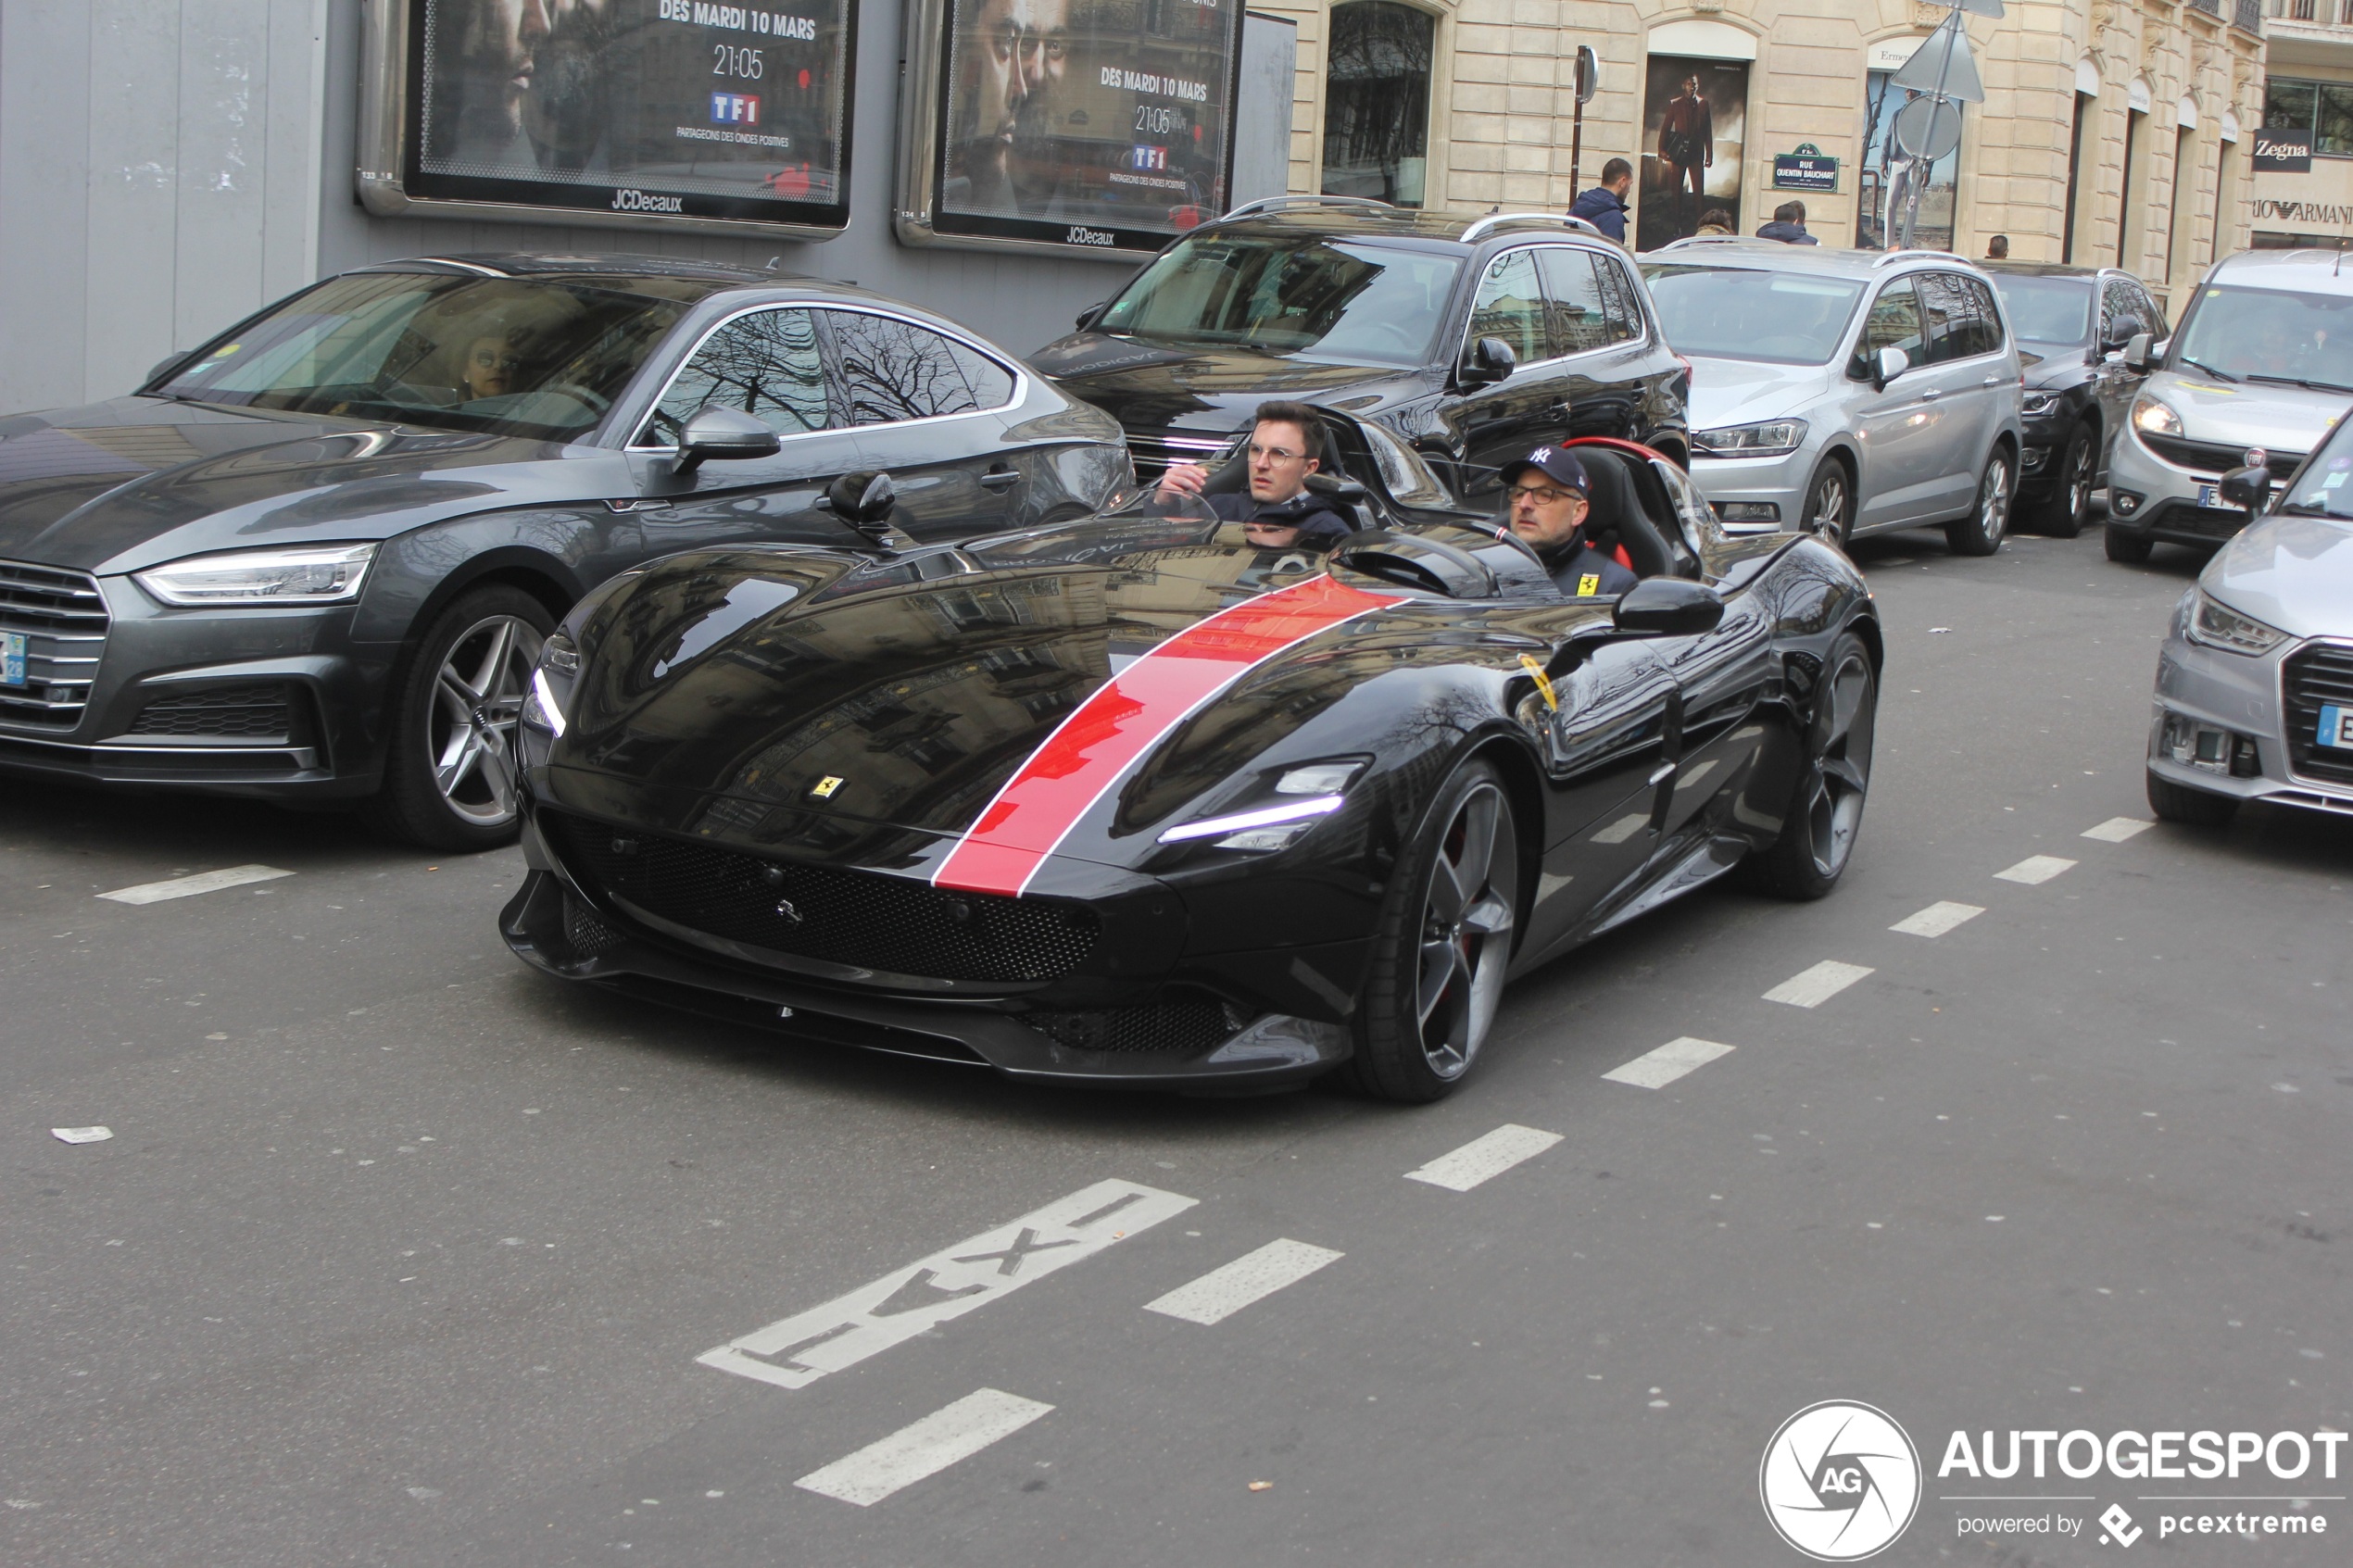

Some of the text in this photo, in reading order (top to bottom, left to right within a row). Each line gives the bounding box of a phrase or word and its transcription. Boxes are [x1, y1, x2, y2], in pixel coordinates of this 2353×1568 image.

[695, 2, 746, 31] MARDI
[751, 11, 770, 34] 10
[773, 14, 816, 41] MARS
[713, 44, 763, 80] 21:05
[1101, 67, 1207, 102] DES MARDI 10 MARS
[714, 95, 756, 122] TF1
[1136, 105, 1170, 134] 21:05
[676, 127, 789, 147] PARTAGEONS DES ONDES POSITIVES
[1136, 148, 1164, 169] TF1
[2255, 140, 2309, 161] Zegna
[1776, 169, 1834, 180] QUENTIN BAUCHART
[1799, 160, 1814, 169] RUE
[1139, 176, 1149, 185] DES
[1150, 178, 1164, 188] ONDES
[611, 189, 683, 212] JCDecaux
[2293, 203, 2353, 224] ARMANI
[1066, 226, 1114, 245] JCDecaux
[2248, 454, 2261, 464] FIAT
[8, 660, 24, 678] 28
[718, 1185, 1158, 1378] TAXI
